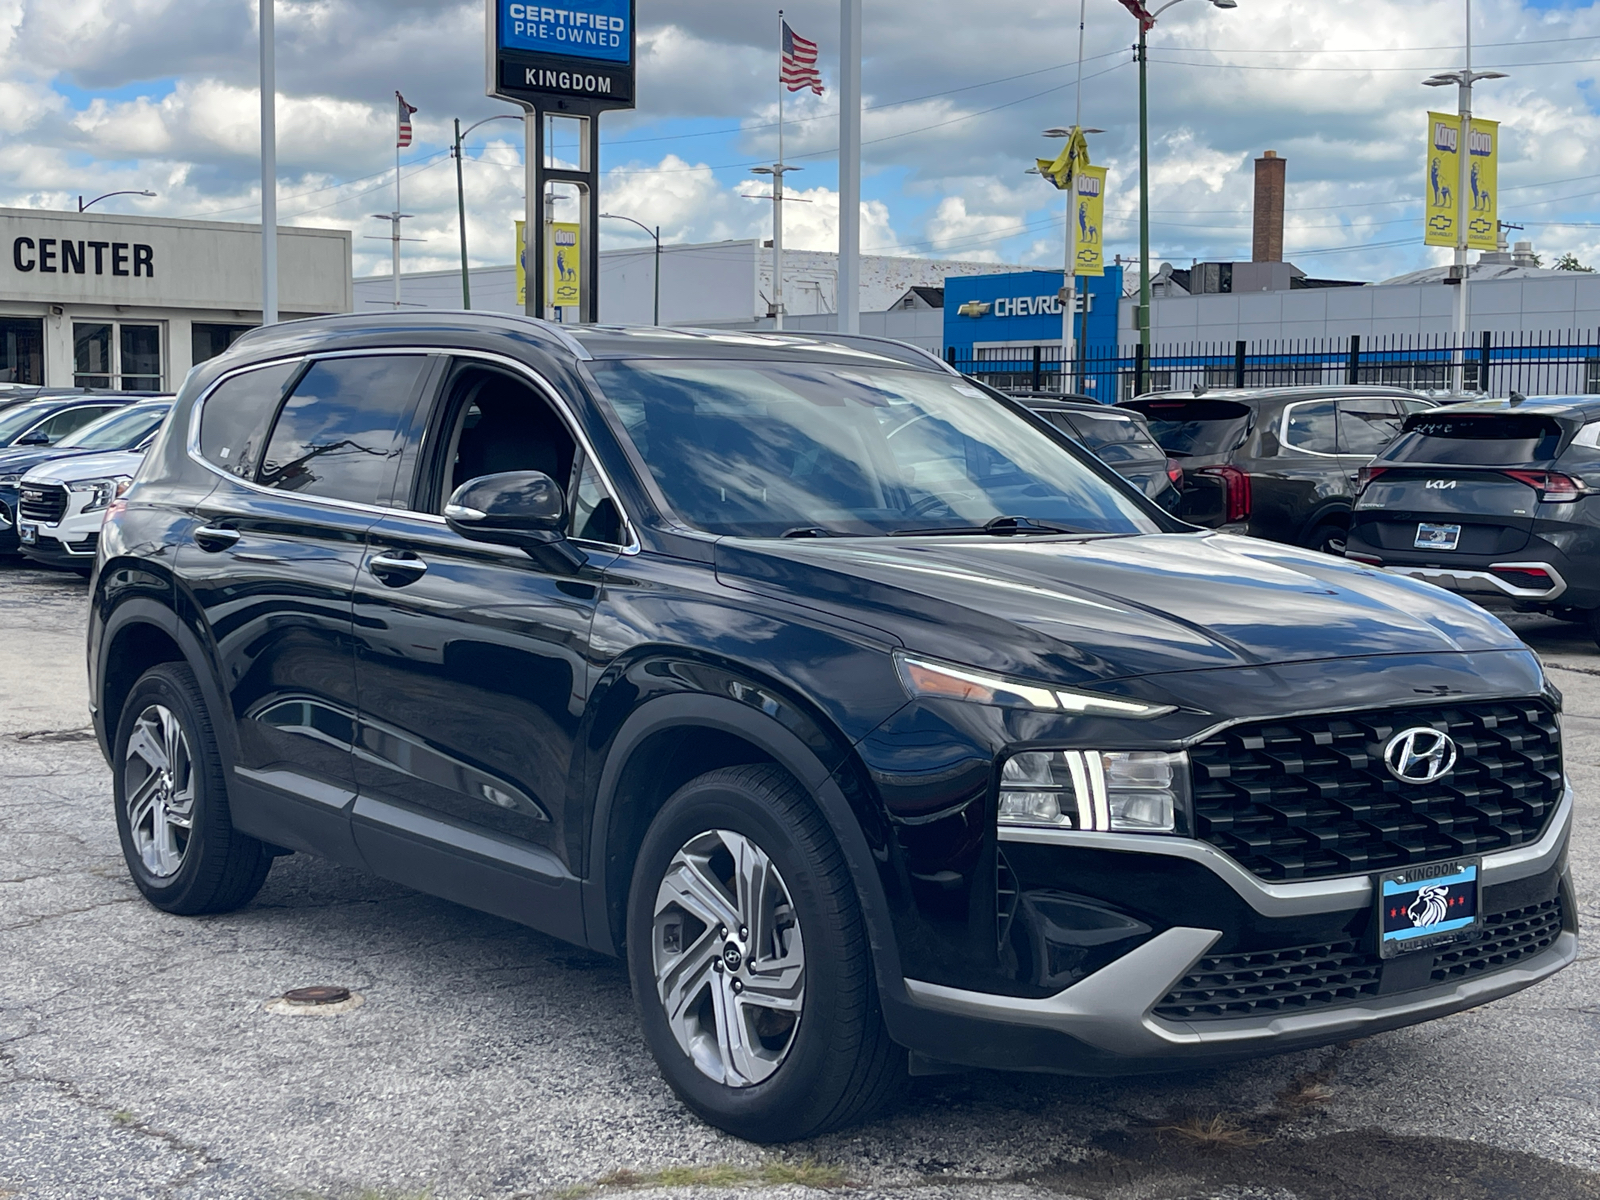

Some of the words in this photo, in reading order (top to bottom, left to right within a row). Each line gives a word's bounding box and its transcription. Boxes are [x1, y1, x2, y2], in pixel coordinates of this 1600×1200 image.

[510, 4, 624, 32] CERTIFIED
[514, 21, 620, 47] PRE-OWNED
[525, 68, 611, 93] KINGDOM
[1434, 122, 1458, 151] King
[1469, 128, 1492, 153] dom
[1078, 174, 1100, 194] dom
[555, 228, 576, 245] dom
[13, 236, 154, 278] CENTER
[994, 293, 1096, 317] CHEVROET
[1425, 479, 1457, 490] KIA
[1405, 862, 1459, 882] KINGDOM
